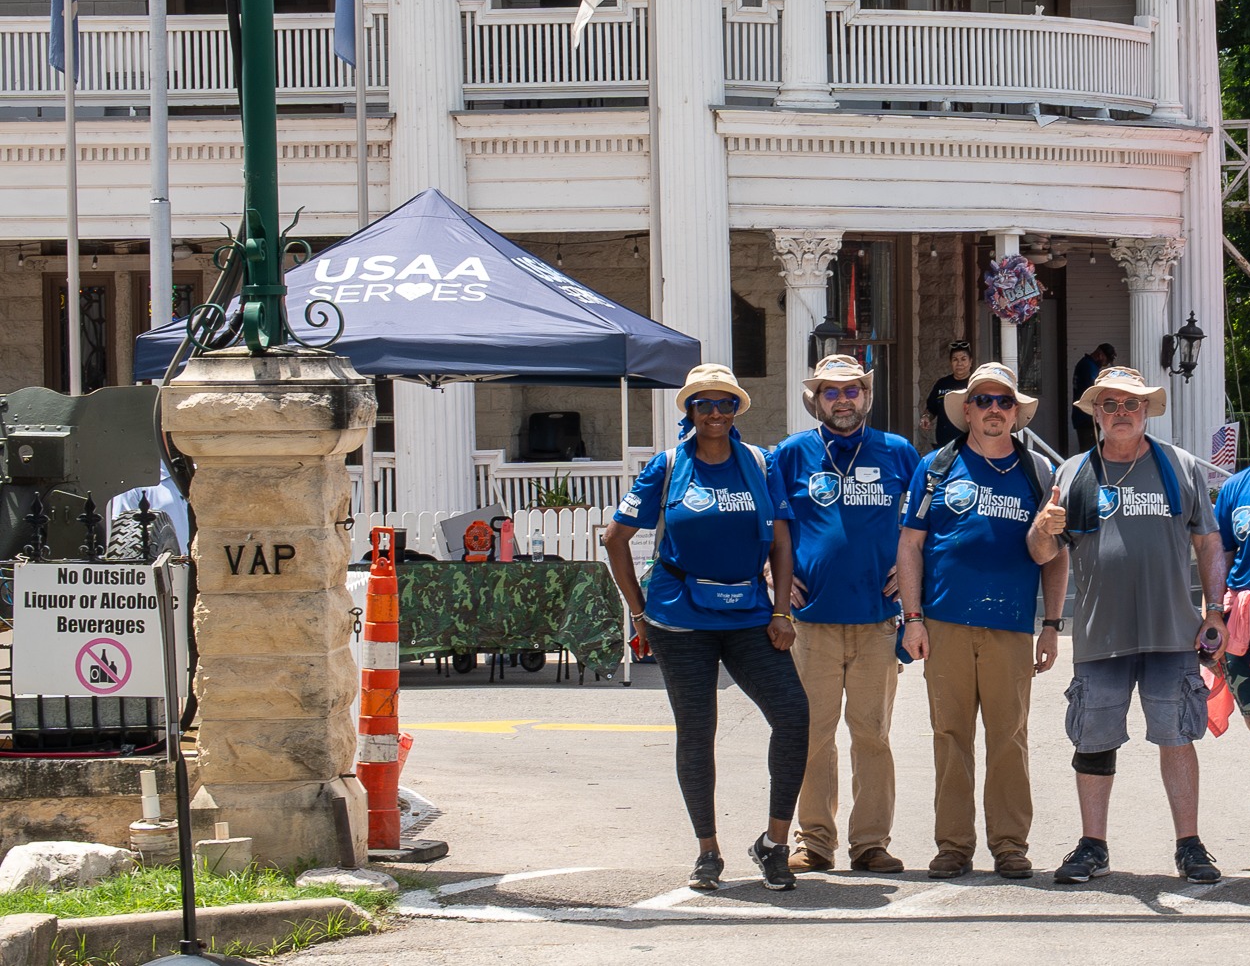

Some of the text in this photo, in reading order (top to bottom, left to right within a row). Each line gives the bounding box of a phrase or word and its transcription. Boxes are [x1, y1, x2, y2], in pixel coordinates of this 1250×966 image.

[314, 253, 491, 283] USAA
[305, 282, 489, 304] SERES
[843, 475, 855, 484] THE
[715, 487, 728, 495] THE
[843, 483, 884, 494] MISSION
[980, 485, 993, 494] THE
[1121, 486, 1135, 494] THE
[718, 491, 753, 502] MISSIO
[843, 494, 893, 506] CONTINUES
[979, 493, 1021, 509] MISSION
[1122, 492, 1164, 504] MISSION
[719, 500, 756, 511] CONTIN
[977, 503, 1030, 522] CONTINUES
[224, 544, 296, 576] VAP
[57, 567, 146, 585] No Outside
[24, 591, 179, 610] Liquor or Alcohoc
[57, 615, 146, 637] Beverages
